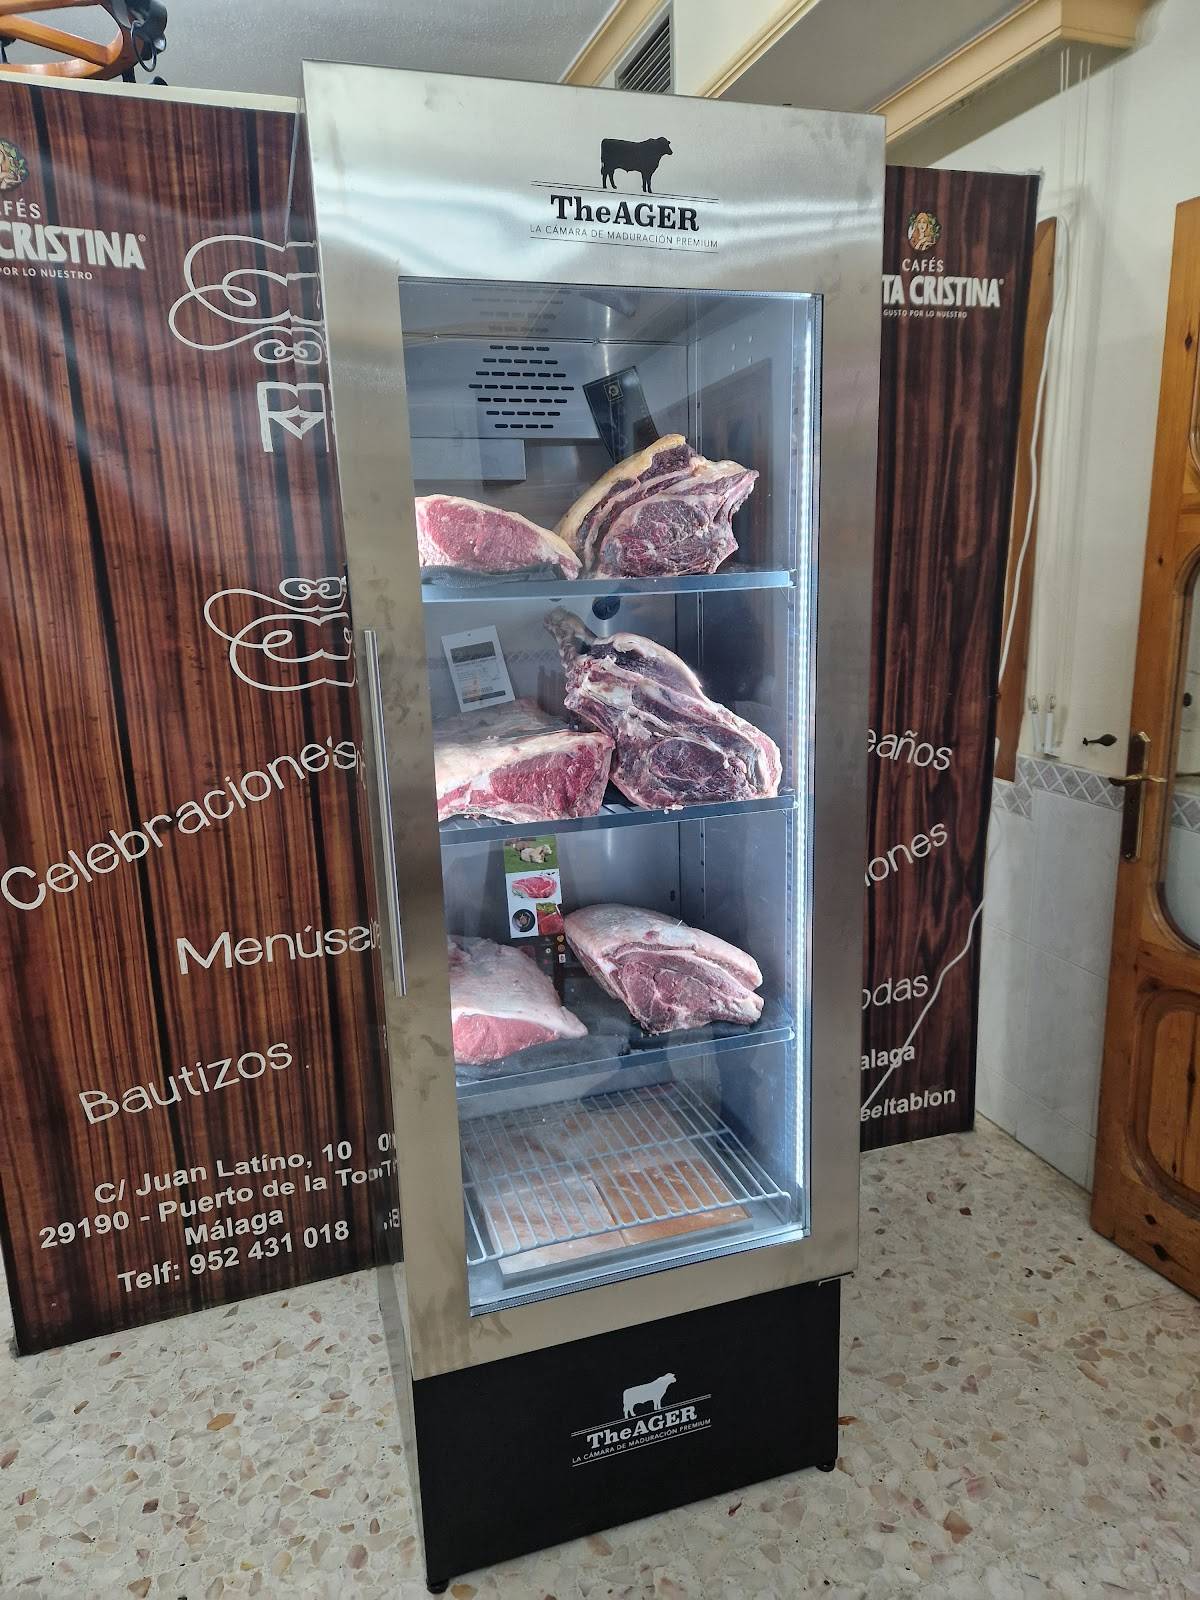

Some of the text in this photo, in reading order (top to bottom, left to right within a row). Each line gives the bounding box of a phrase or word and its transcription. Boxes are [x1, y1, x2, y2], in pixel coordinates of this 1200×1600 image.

[0, 198, 41, 219] FÉS
[550, 194, 700, 231] TheAGER
[0, 220, 145, 270] CRISTINA
[530, 225, 718, 248] LA CÁMARA DE MADURACIÓN PREMIUM
[22, 268, 37, 277] LO
[40, 269, 93, 280] NUESTRO
[902, 257, 944, 272] CAFÉS
[909, 275, 1000, 307] CRISTINA
[883, 309, 908, 317] GUSTO
[1, 736, 332, 910] Celebracione
[78, 1042, 293, 1124] Bautizos
[94, 1178, 126, 1204] C/
[135, 1165, 207, 1197] Juan
[321, 1141, 352, 1162] 10
[38, 1210, 129, 1248] 29190
[158, 1183, 253, 1223] Puerto
[262, 1174, 295, 1198] de
[304, 1173, 328, 1192] la
[184, 1209, 284, 1246] Málaga
[117, 1261, 181, 1292] Telf:
[190, 1246, 240, 1276] 952
[248, 1236, 293, 1262] 431
[303, 1220, 350, 1249] 018
[572, 1418, 711, 1464] LA CÁMARA DE MADURACIÓN PREMIUM
[586, 1405, 698, 1449] TheAGER
